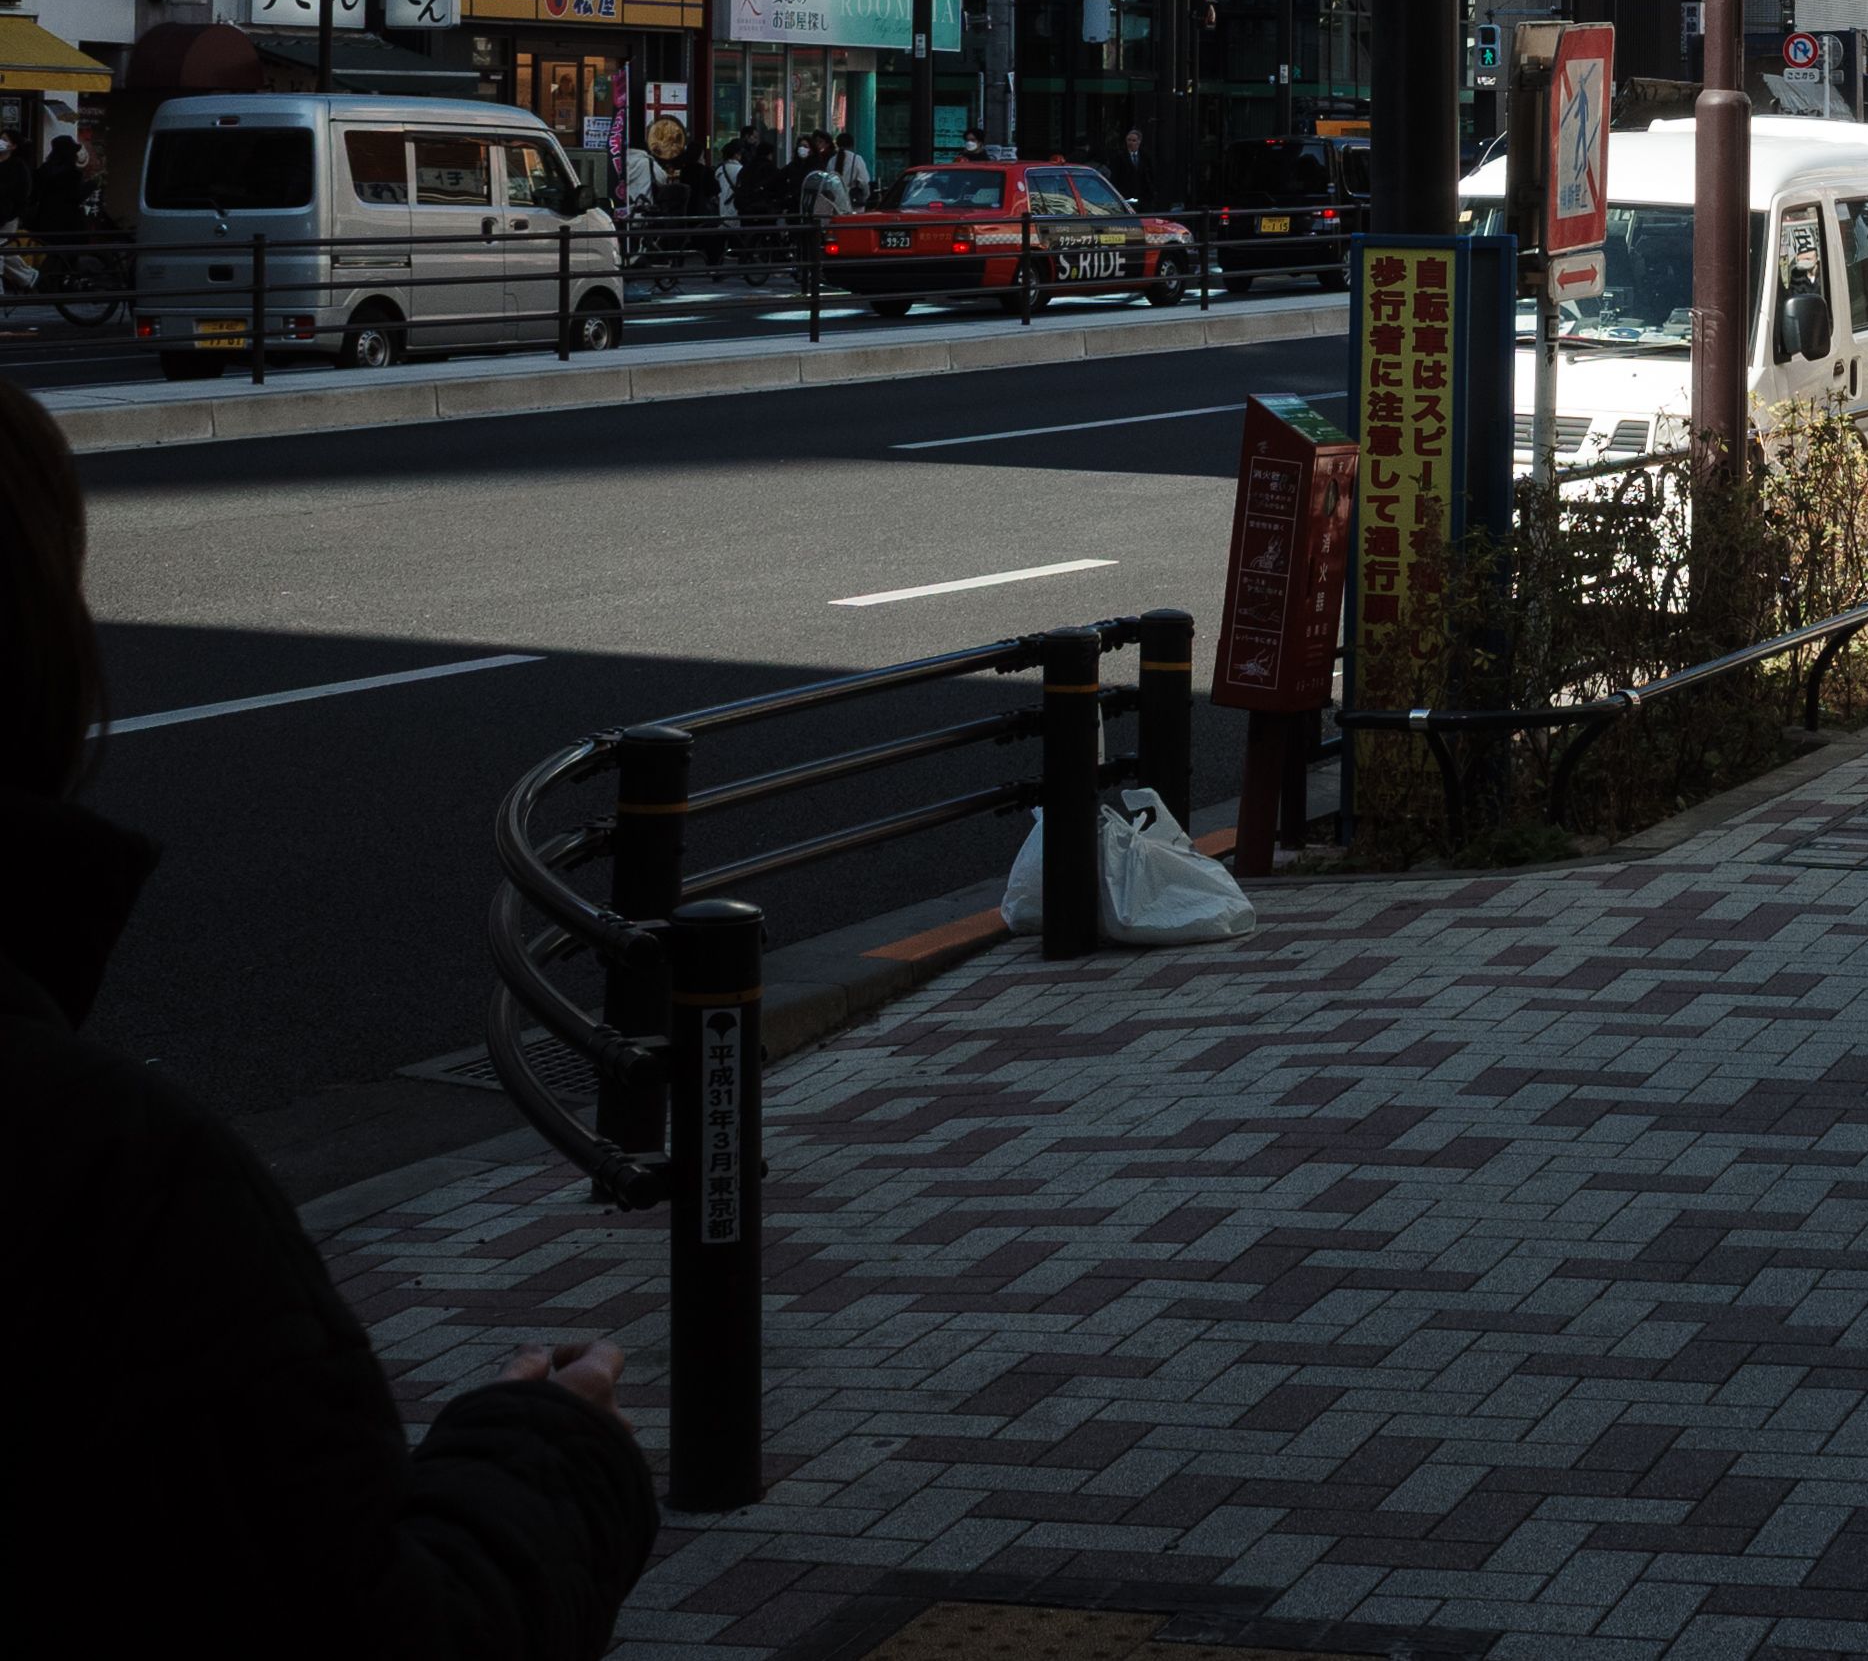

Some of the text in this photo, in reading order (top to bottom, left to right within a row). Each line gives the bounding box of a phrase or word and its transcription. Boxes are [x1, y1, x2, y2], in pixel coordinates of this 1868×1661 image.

[772, 10, 829, 31] お部屋探し
[1787, 72, 1815, 80] ここから
[707, 1044, 736, 1240] 平成31年3月東京都
